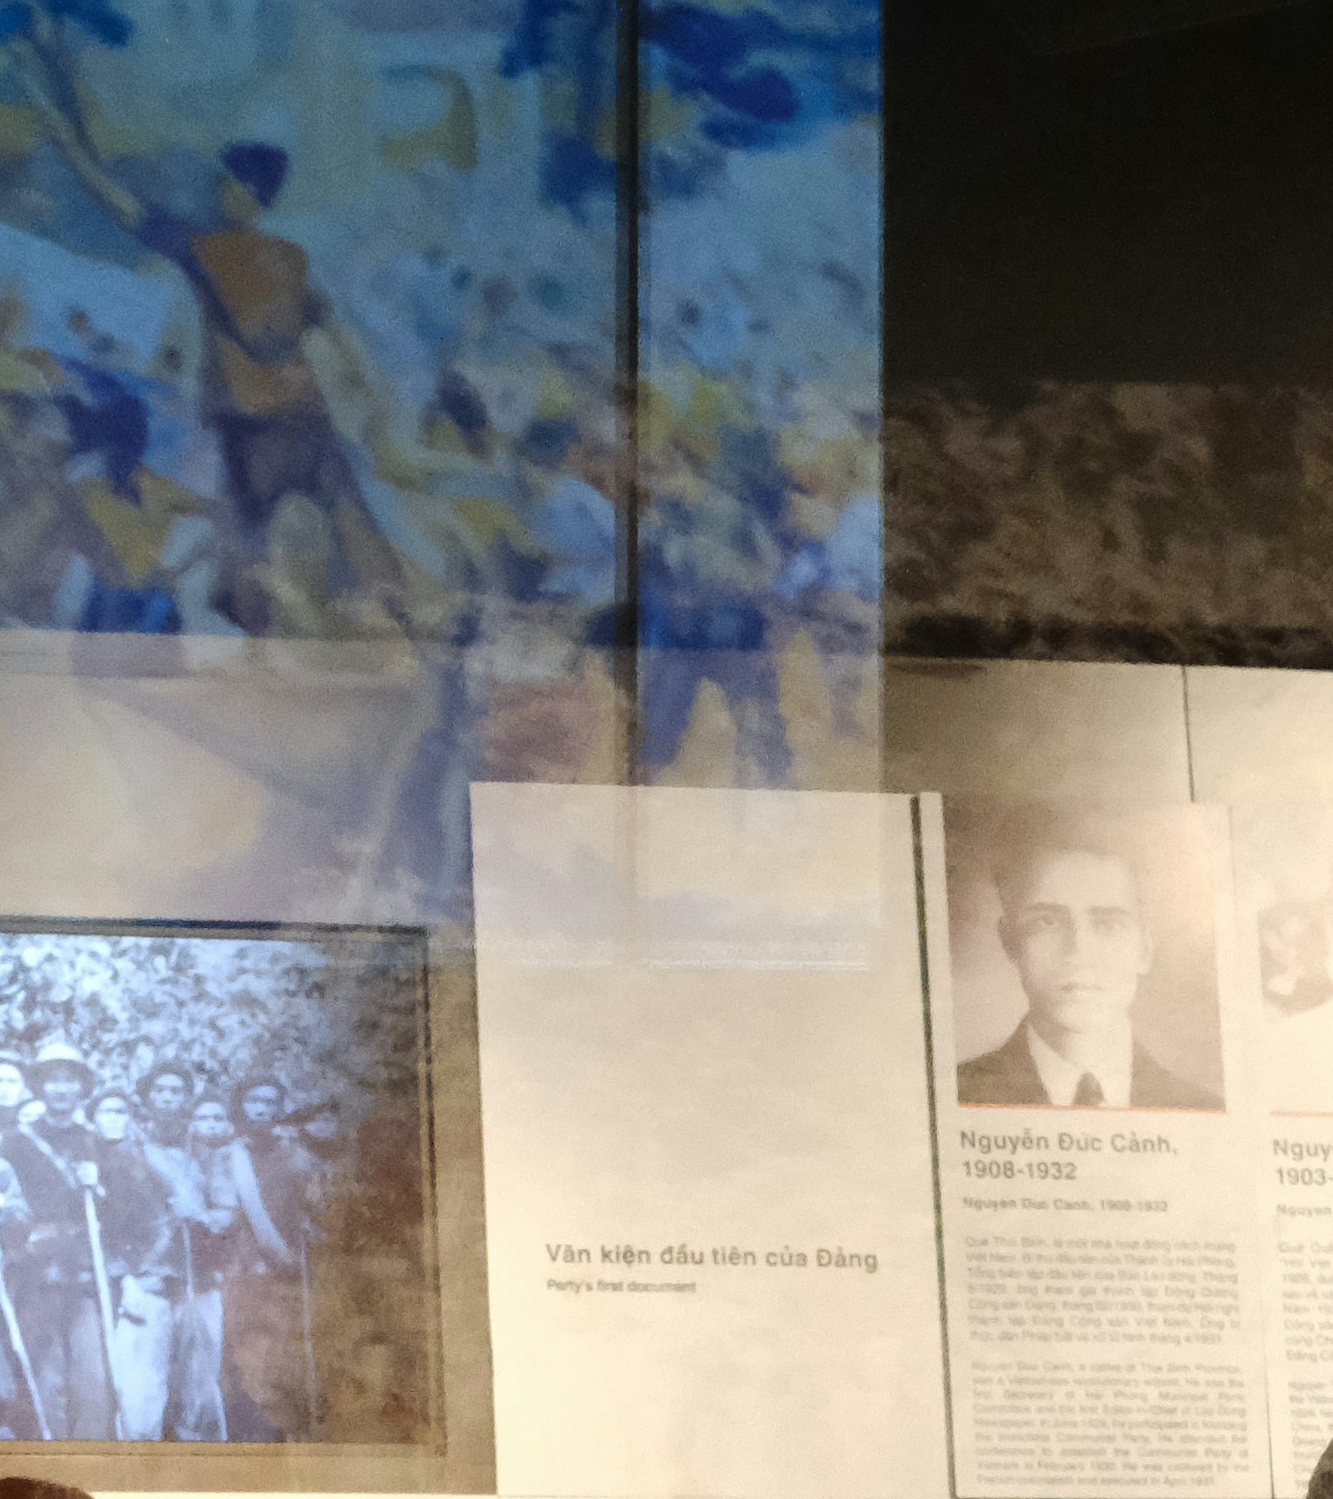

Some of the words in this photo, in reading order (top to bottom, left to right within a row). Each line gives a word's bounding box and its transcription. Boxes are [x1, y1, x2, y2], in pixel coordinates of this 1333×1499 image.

[960, 1128, 1050, 1155] Nguyễn
[962, 1160, 1078, 1181] 1908-1932
[545, 1243, 591, 1264] Văn
[600, 1244, 652, 1268] kiện
[660, 1243, 705, 1264] đầu
[712, 1246, 757, 1266] tiên
[765, 1244, 808, 1267] của
[815, 1245, 880, 1273] Đảng
